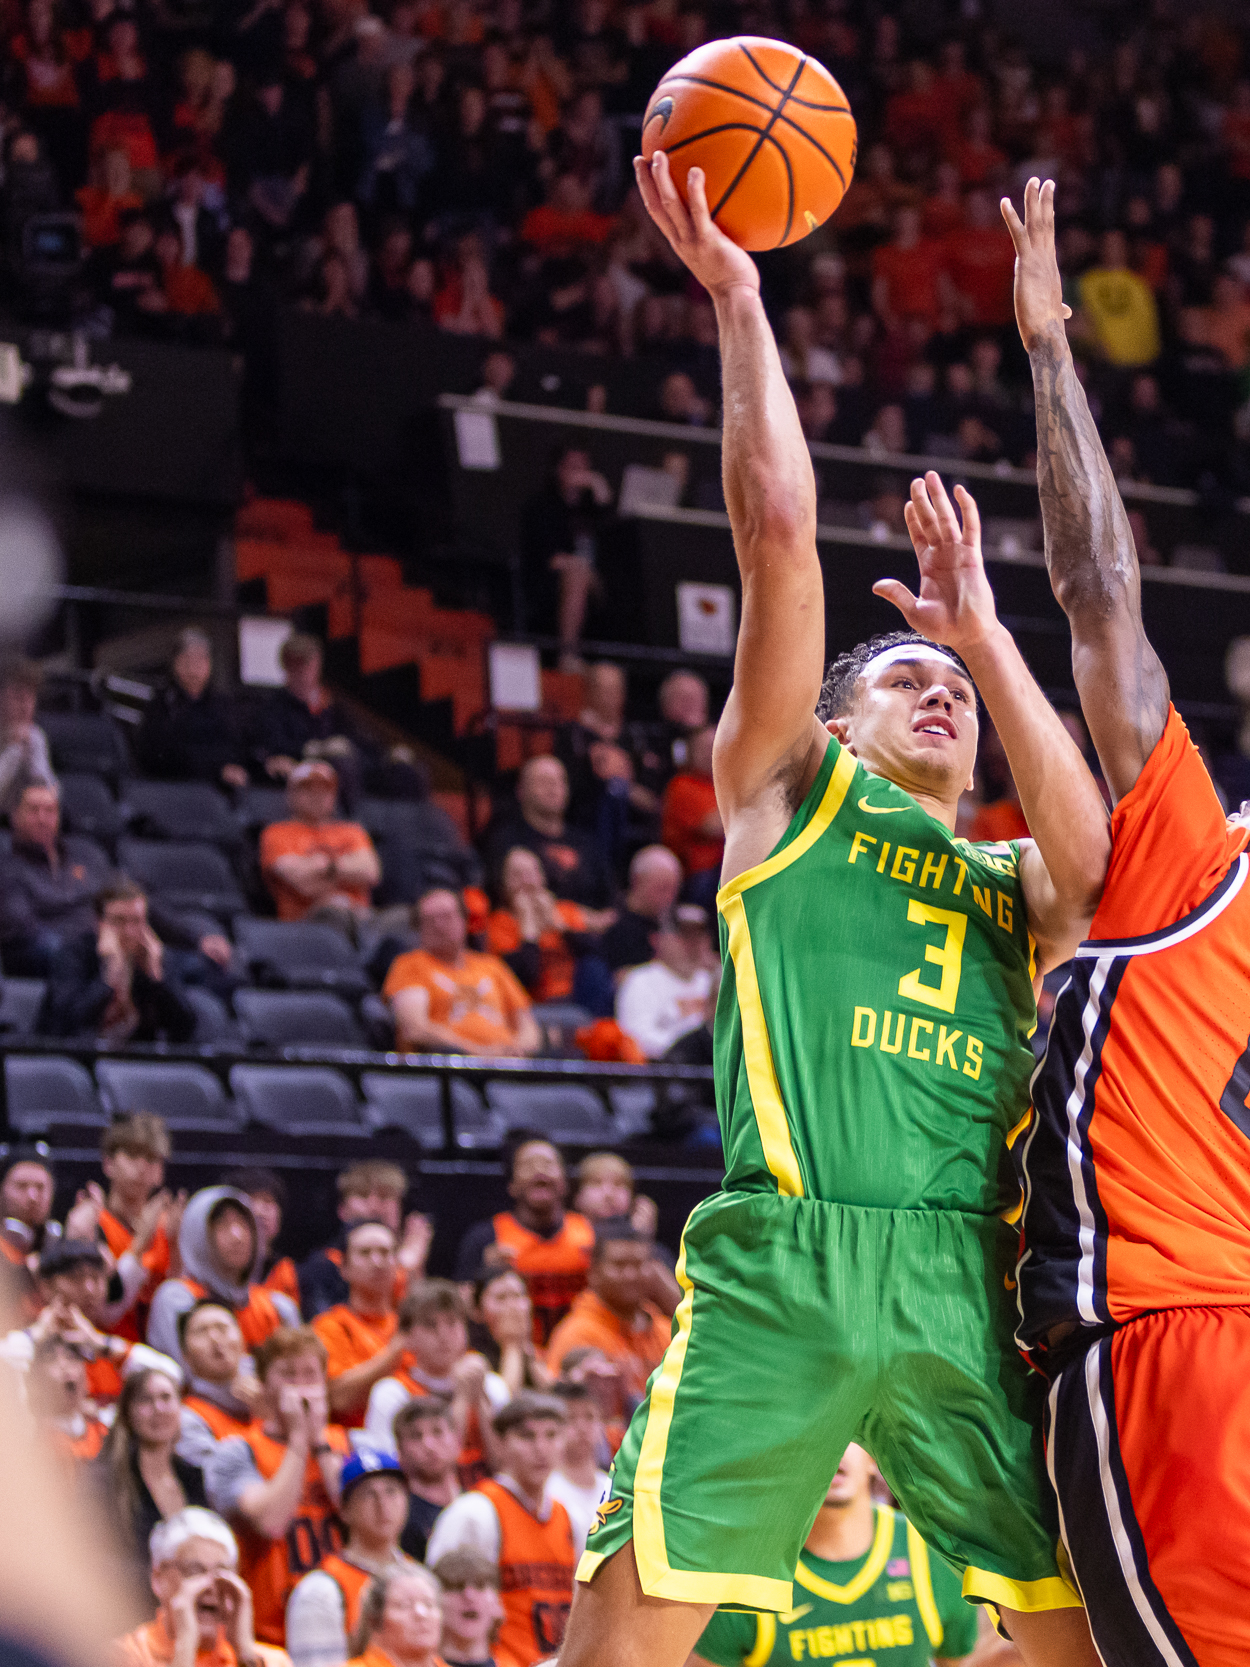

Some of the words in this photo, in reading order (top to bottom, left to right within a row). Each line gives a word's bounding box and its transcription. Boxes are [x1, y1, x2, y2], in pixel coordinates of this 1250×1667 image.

[847, 831, 1014, 934] FIGHTNG
[897, 898, 968, 1014] 3
[850, 1005, 984, 1081] DUCKS
[788, 1613, 915, 1662] FIGHTING
